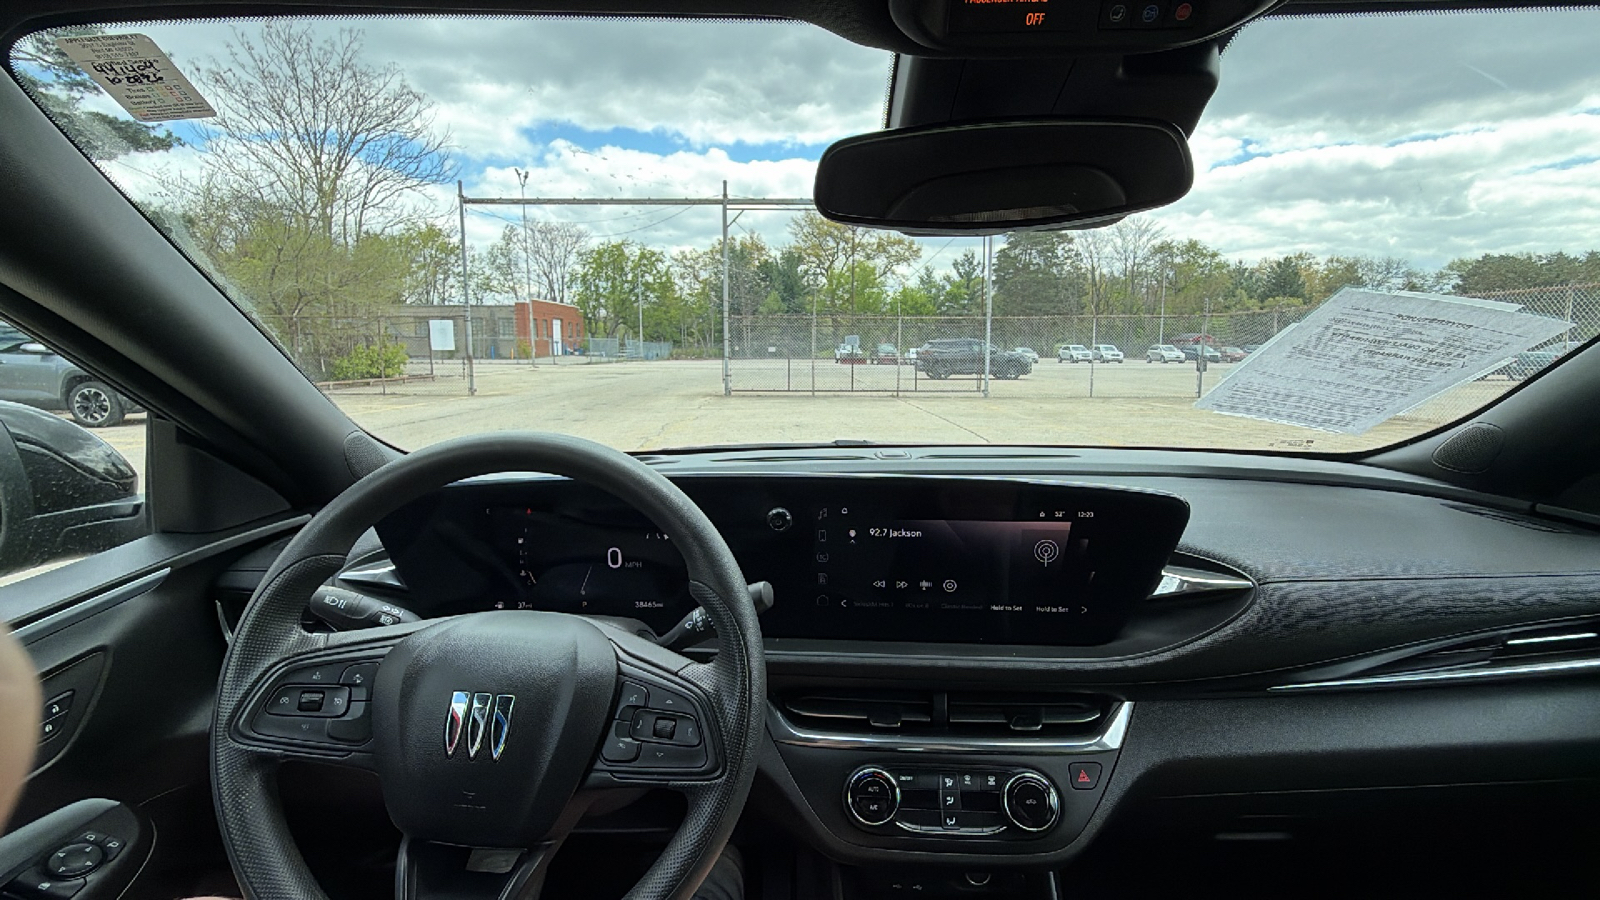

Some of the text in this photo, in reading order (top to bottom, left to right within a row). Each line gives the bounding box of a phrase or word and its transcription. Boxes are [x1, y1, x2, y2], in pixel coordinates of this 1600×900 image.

[1026, 12, 1046, 26] OFF
[870, 528, 922, 538] 92.7 Jackson
[608, 547, 622, 568] 0
